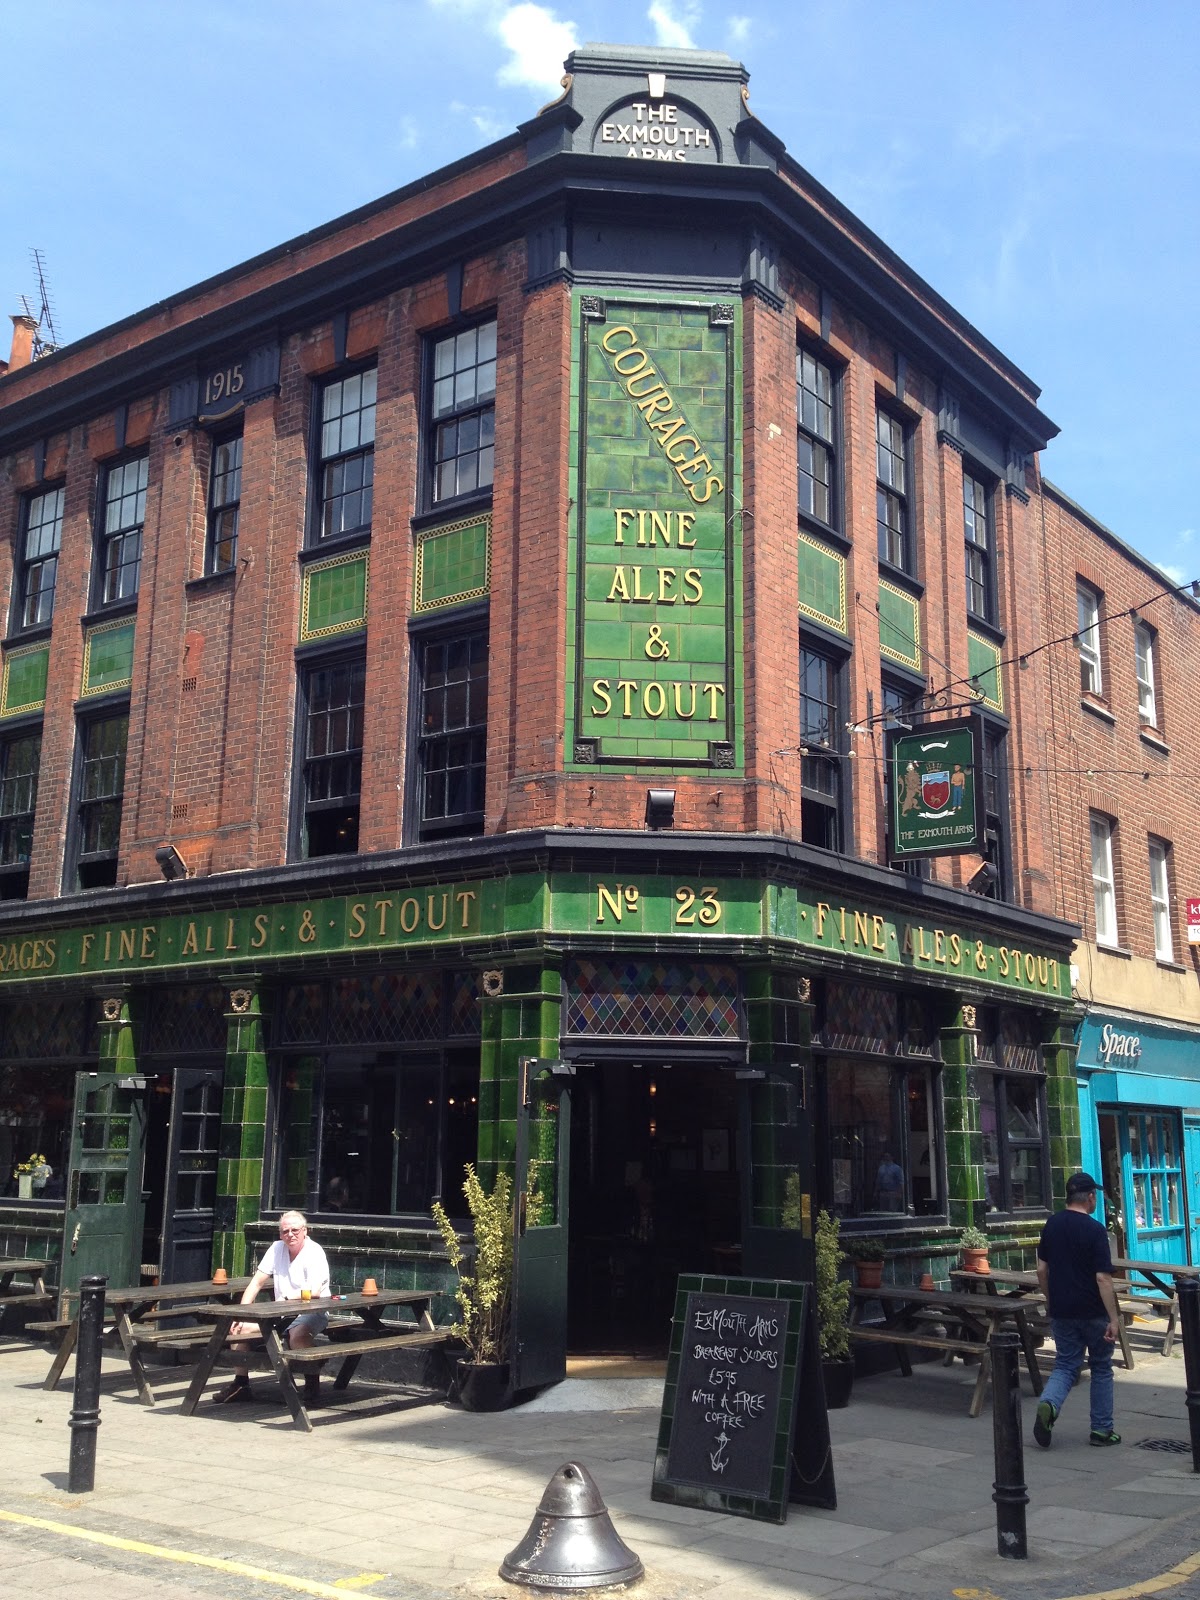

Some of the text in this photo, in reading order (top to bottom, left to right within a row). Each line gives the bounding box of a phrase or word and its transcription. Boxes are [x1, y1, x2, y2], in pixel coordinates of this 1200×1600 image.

[632, 103, 678, 123] THE
[602, 123, 710, 148] EXMOUTH
[205, 364, 244, 405] 1915
[602, 325, 724, 503] COURAGES
[614, 508, 697, 549] FINE
[606, 565, 703, 604] ALES
[645, 624, 670, 658] &
[591, 679, 725, 721] STOUT
[900, 824, 974, 840] THE EXMOUTH ARMS
[675, 885, 722, 925] 23
[80, 926, 156, 964] FINE
[298, 909, 316, 943] &
[349, 891, 476, 938] STOUT
[817, 902, 1057, 989] FINE ALES & STOUT
[1099, 1023, 1140, 1063] Space
[693, 1344, 778, 1369] BREAKFAST SLIDERS
[691, 1388, 766, 1419] WITH A FREE
[705, 1411, 745, 1430] COFFEE
